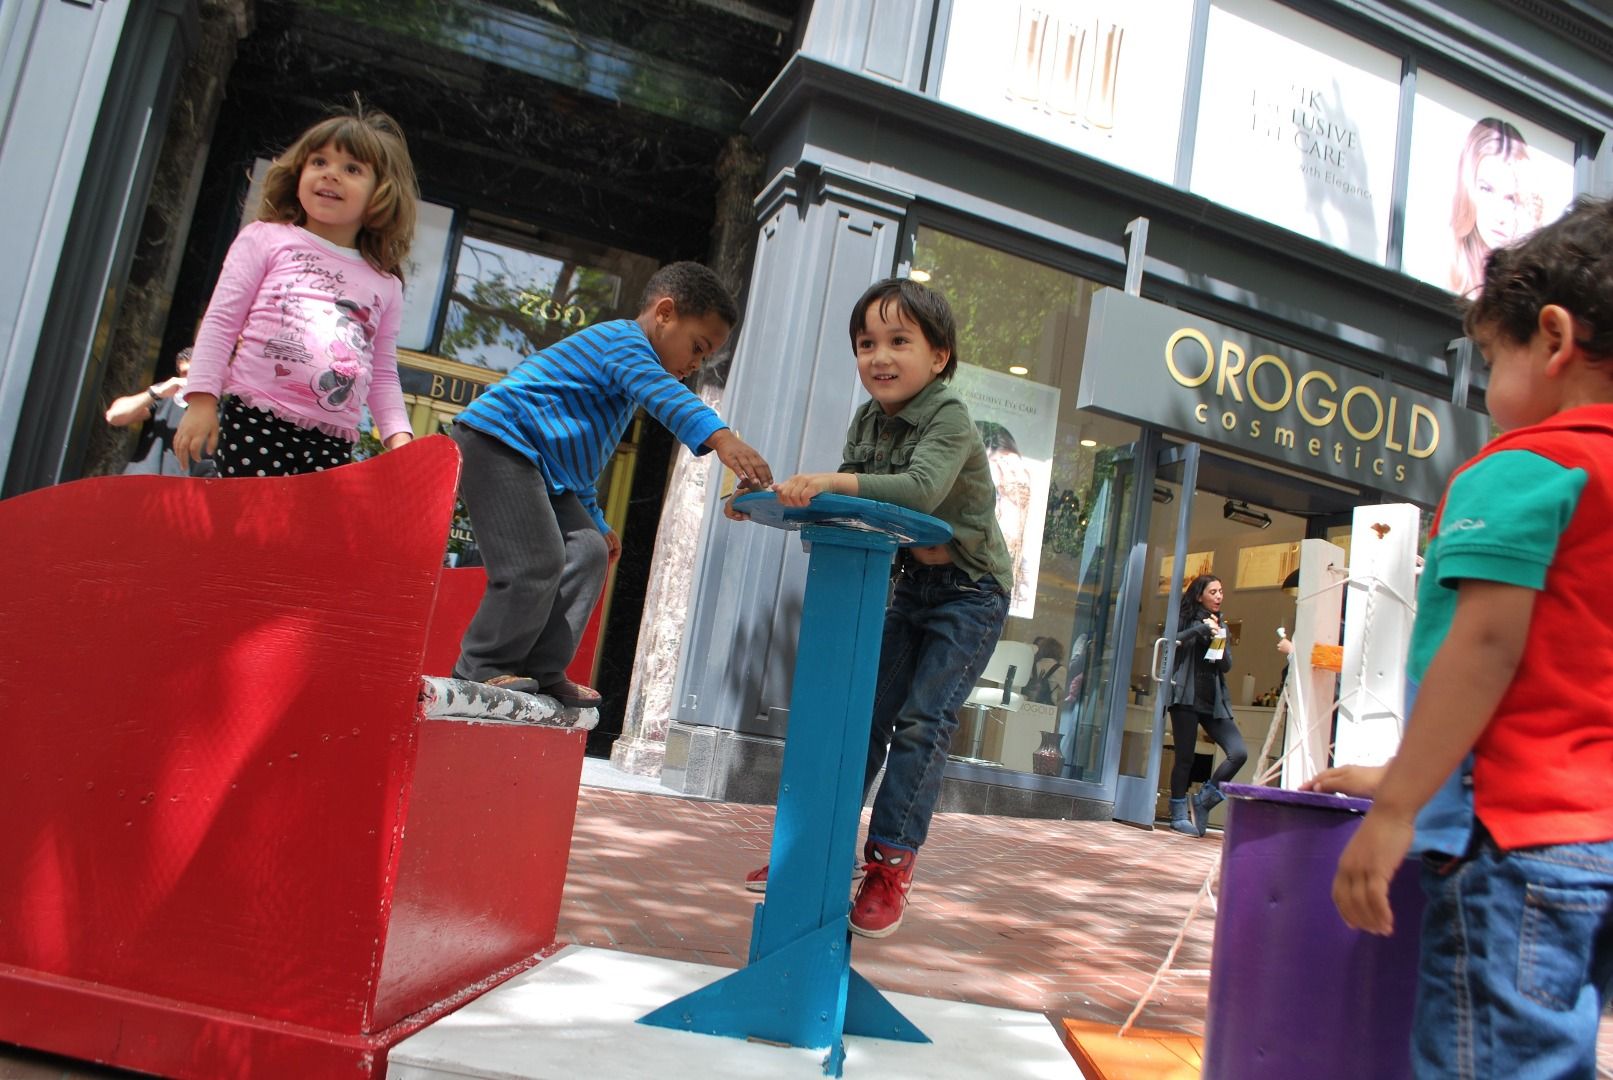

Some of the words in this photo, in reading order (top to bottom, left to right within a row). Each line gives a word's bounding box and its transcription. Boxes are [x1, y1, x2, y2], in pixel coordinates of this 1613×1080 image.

[1294, 131, 1345, 169] CARE
[295, 261, 347, 285] York
[309, 277, 347, 298] City
[430, 374, 479, 403] BUI
[1165, 327, 1440, 459] OROGOLD
[1194, 402, 1406, 482] cosmetics
[450, 528, 473, 542] ULL
